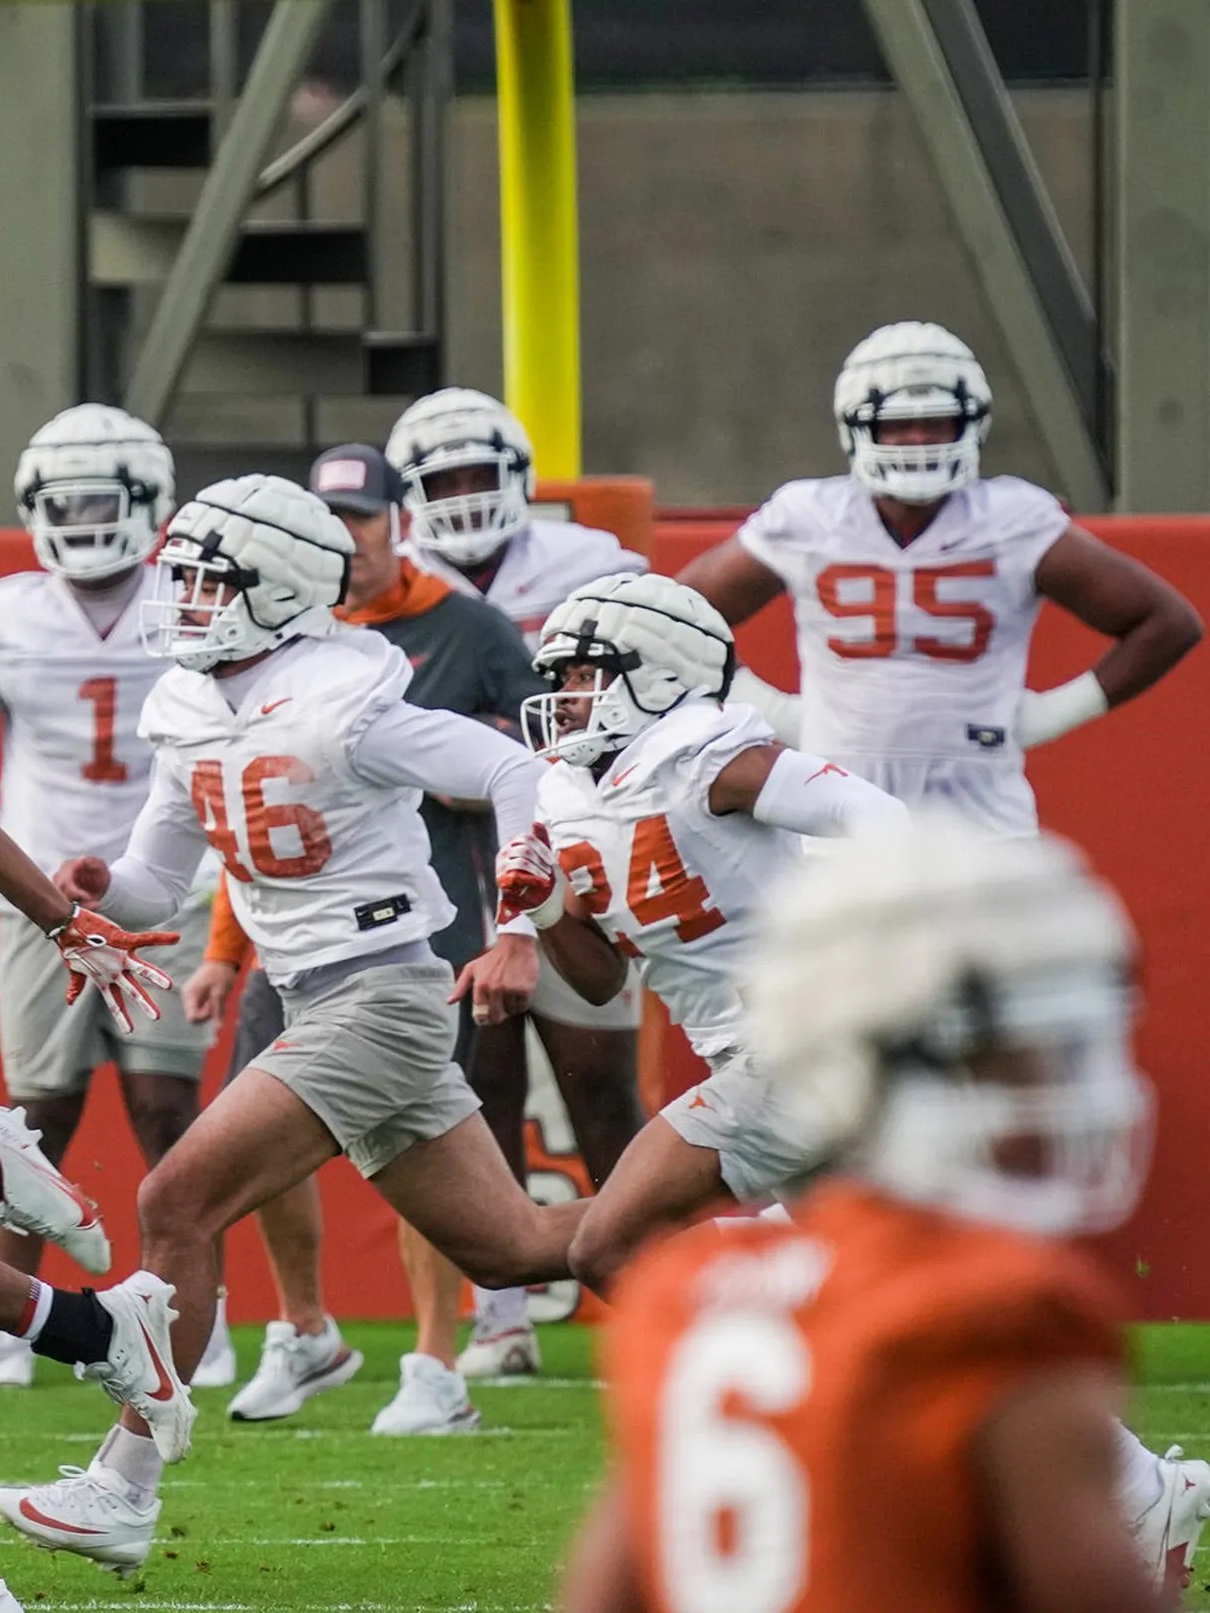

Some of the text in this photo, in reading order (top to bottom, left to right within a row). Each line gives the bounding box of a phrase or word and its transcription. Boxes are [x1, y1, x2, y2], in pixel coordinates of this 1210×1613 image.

[817, 559, 996, 663] 95
[78, 676, 128, 784] 1
[192, 756, 332, 882] 46
[658, 1310, 812, 1613] 6
